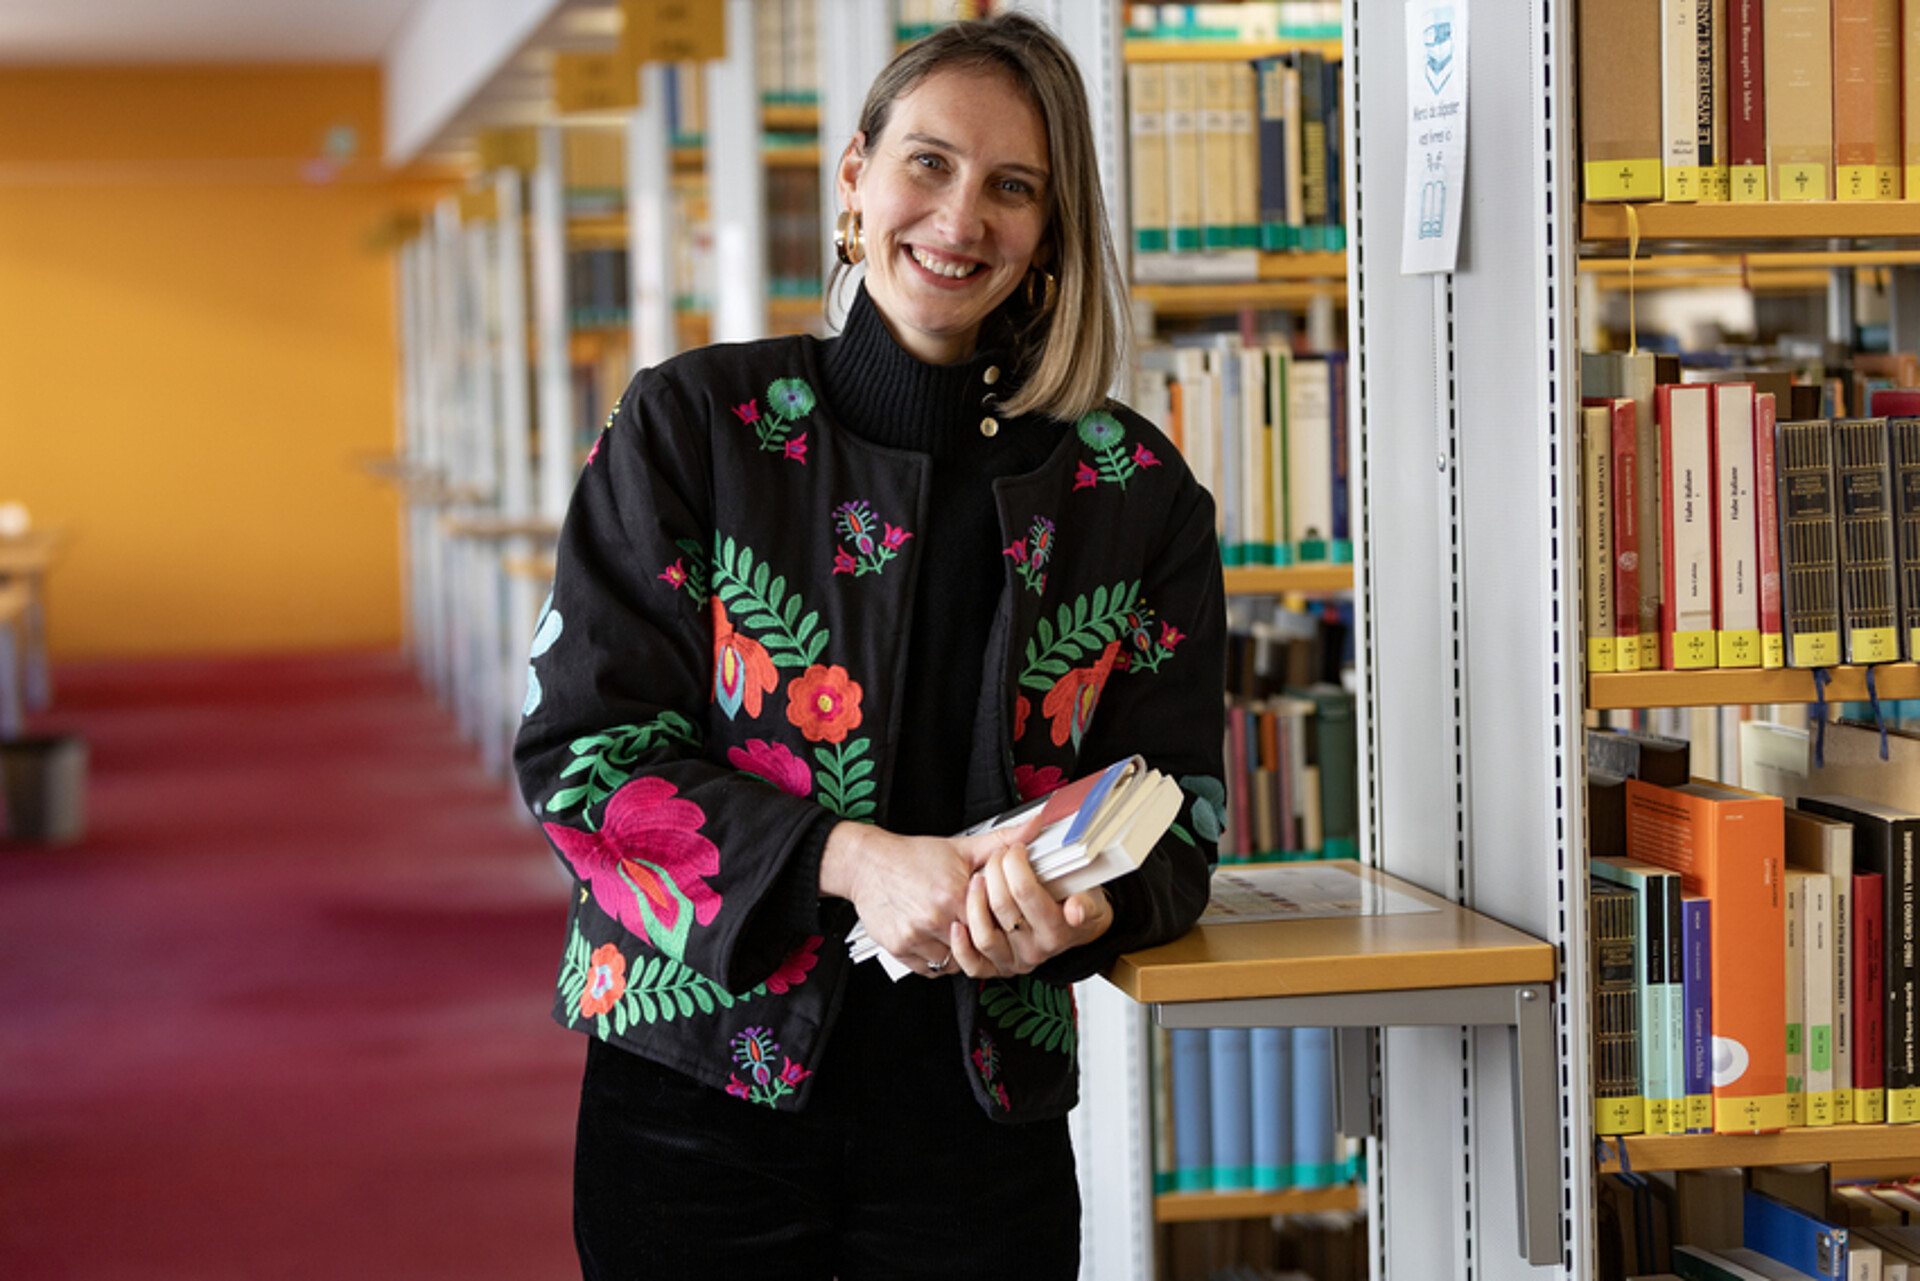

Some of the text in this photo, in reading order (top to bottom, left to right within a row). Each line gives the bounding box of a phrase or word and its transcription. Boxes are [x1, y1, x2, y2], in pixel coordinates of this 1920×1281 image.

[1698, 40, 1710, 57] DE
[1698, 128, 1710, 145] LE
[1597, 454, 1605, 507] RAMPANTE
[1685, 501, 1693, 523] Fiabe
[1731, 498, 1739, 520] Fiabe
[1598, 512, 1606, 550] BARONE
[1599, 573, 1607, 618] CALVINO
